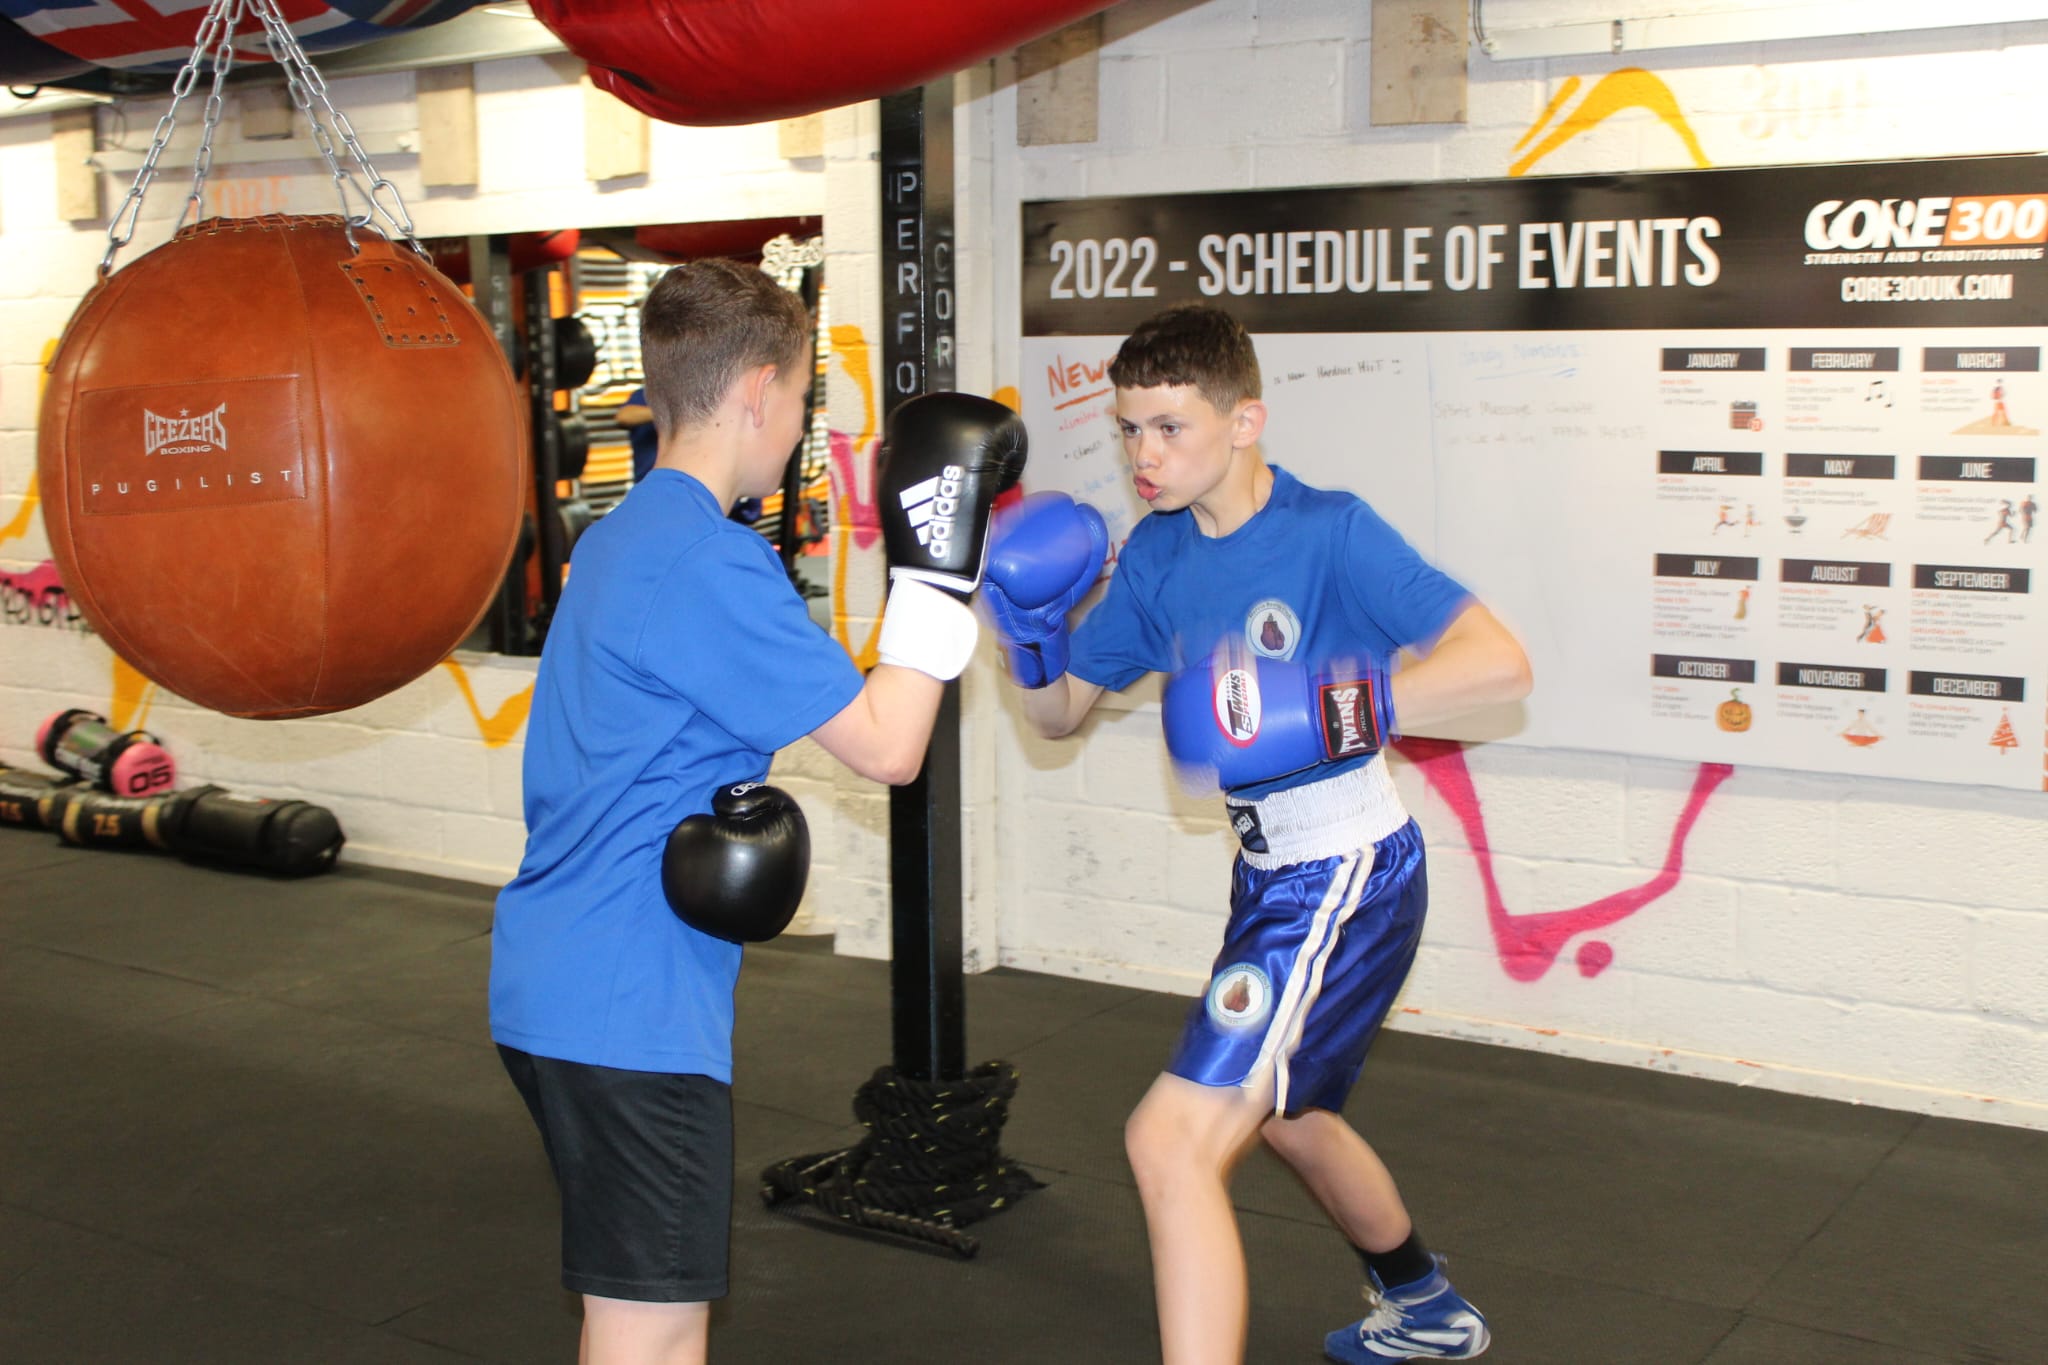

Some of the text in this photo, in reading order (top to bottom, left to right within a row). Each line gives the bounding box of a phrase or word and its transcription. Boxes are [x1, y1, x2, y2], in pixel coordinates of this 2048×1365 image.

[1804, 197, 2048, 250] CORE 300
[1050, 236, 1158, 299] 2022
[1198, 226, 1433, 297] SCHEDULE
[1445, 223, 1508, 291] OF
[1518, 216, 1722, 289] EVENTS
[1803, 248, 2045, 265] STRENGTH AND CONDITIONING
[1841, 274, 2014, 302] CORE300UK.COM
[934, 242, 953, 392] COR
[1686, 353, 1739, 368] JANUARY
[1811, 353, 1875, 368] FEBRUARY
[1957, 353, 2004, 368] MARCH
[144, 402, 227, 457] GEEZERS
[160, 444, 212, 455] BOXING
[1692, 457, 1727, 472] APRIL
[1824, 460, 1854, 475] MAY
[1959, 462, 1993, 479] JUNE
[92, 470, 291, 495] PUGILIST
[929, 464, 964, 559] adidas
[1692, 560, 1720, 576] JULY
[1811, 566, 1860, 583] AUGUST
[1934, 571, 2010, 590] SEPTEMBER
[1678, 661, 1730, 679] OCTOBER
[1799, 669, 1865, 688] NOVEMBER
[1933, 678, 2001, 697] DECEMBER
[1226, 672, 1253, 737] TWINS
[1329, 687, 1368, 754] TWINS
